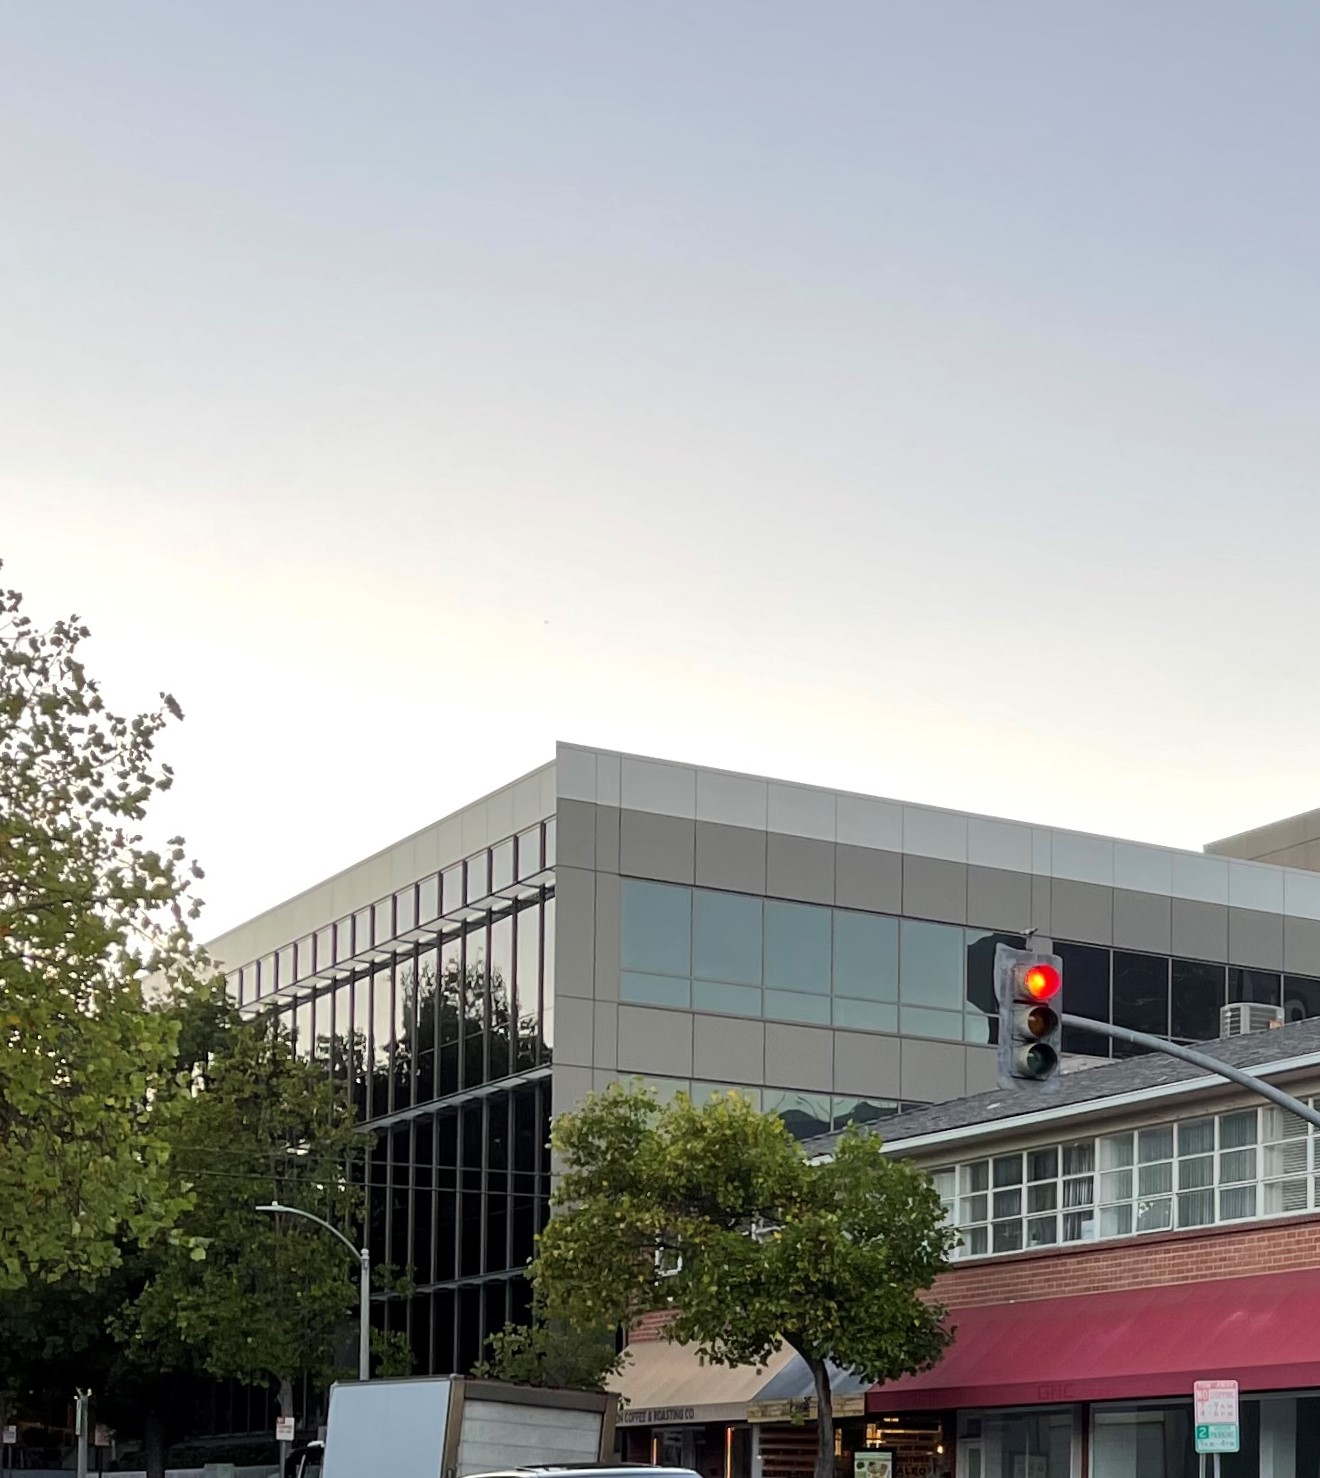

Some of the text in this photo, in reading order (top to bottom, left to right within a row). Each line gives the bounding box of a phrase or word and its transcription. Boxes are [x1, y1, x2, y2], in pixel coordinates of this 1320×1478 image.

[1037, 1383, 1075, 1400] GNC
[624, 1411, 647, 1424] COFFEE
[653, 1408, 684, 1421] ROASTING
[1198, 1426, 1208, 1439] 2
